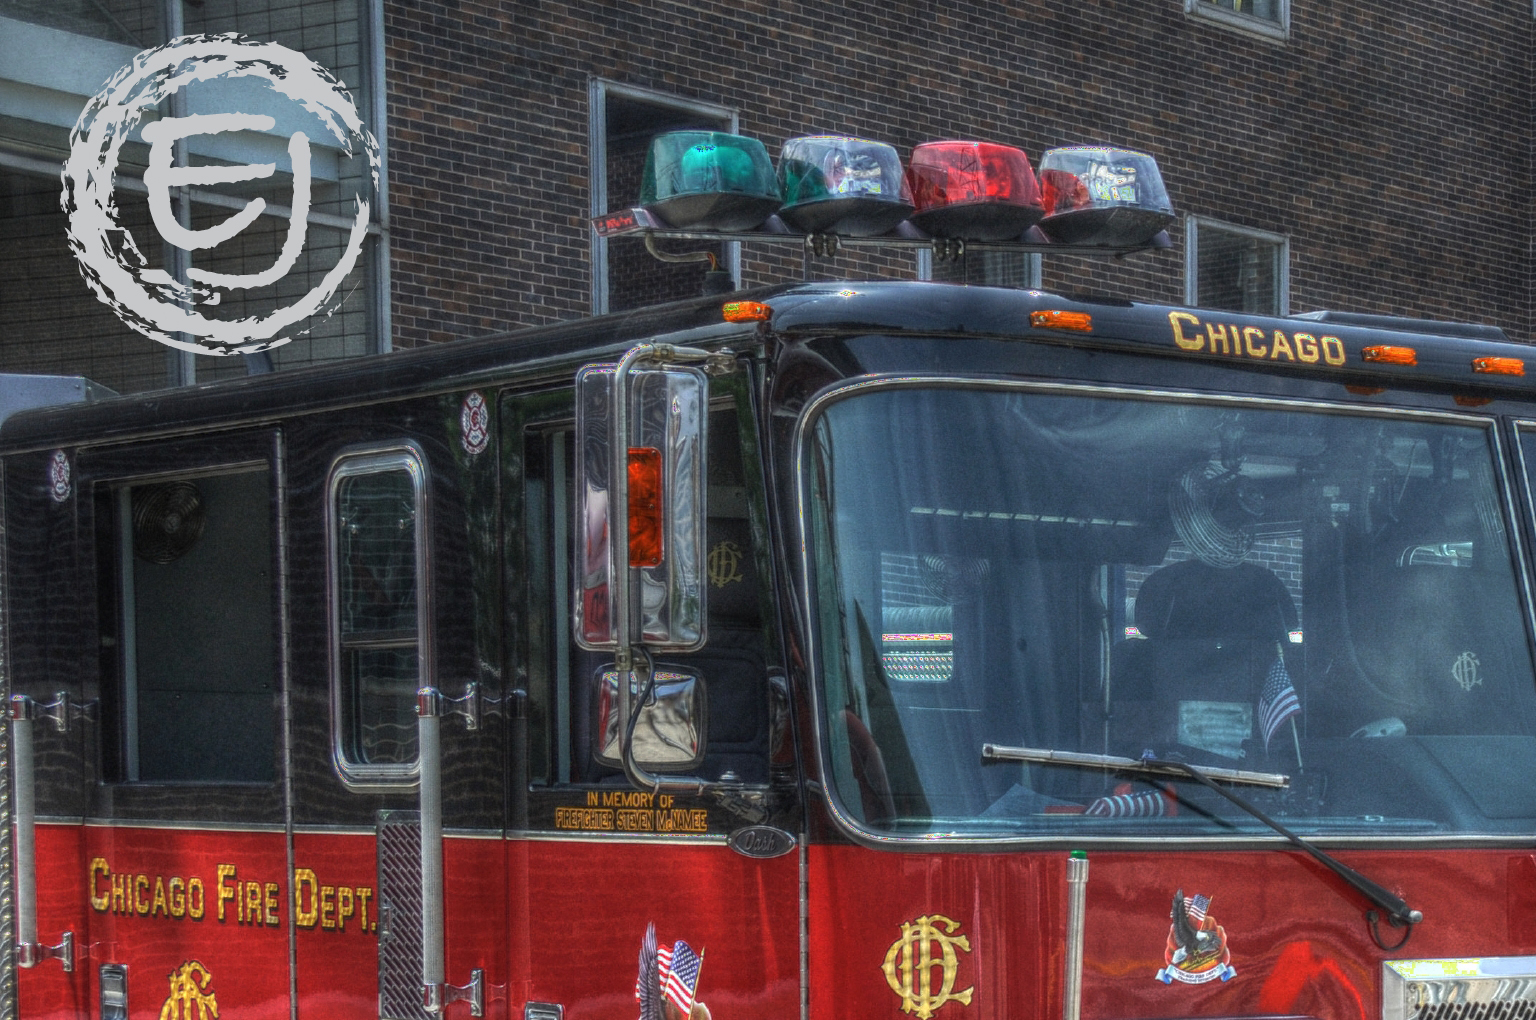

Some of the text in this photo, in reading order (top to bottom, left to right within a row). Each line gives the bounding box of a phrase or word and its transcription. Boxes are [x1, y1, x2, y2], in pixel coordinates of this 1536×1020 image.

[1168, 310, 1346, 367] CHICAGO
[555, 808, 614, 830] FIREFIGHTER
[616, 810, 654, 831] STEVEN
[587, 791, 675, 808] IN MEMORY OF
[89, 857, 378, 932] CHICAGO FIRE DEPT.
